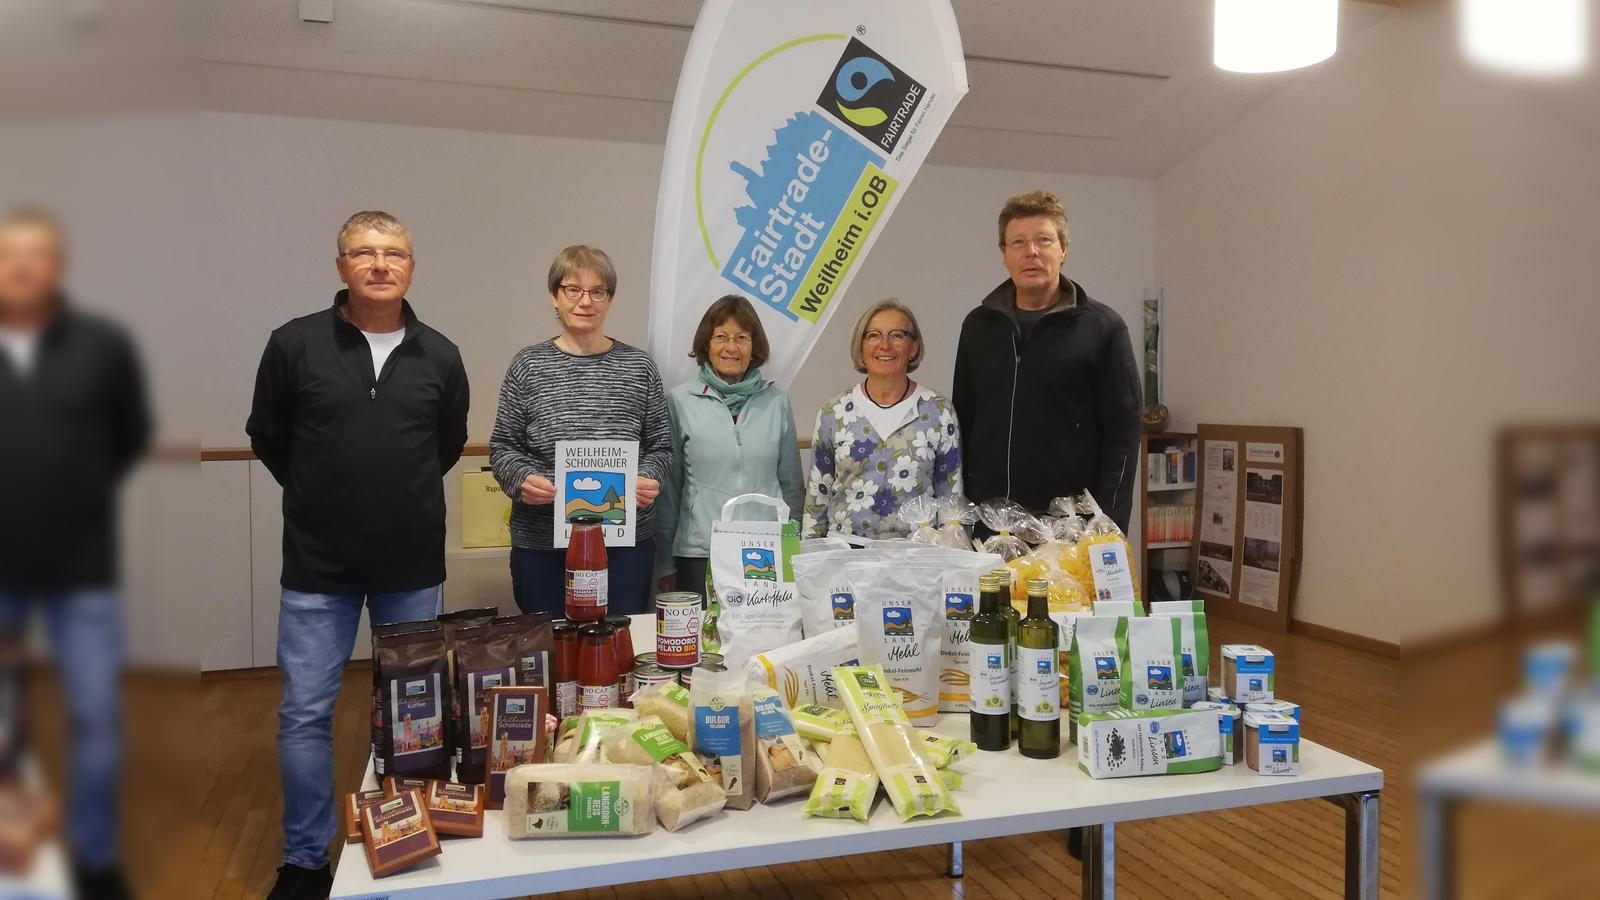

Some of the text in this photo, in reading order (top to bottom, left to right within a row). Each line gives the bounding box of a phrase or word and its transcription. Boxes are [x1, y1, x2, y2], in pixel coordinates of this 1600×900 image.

[880, 84, 921, 148] FAIRTRADE
[895, 151, 904, 161] Das
[902, 135, 913, 150] Siegel
[732, 129, 833, 288] Fairtrade-
[799, 174, 888, 314] Weilheim i.OB
[759, 211, 826, 303] Stadt
[565, 447, 628, 457] WEILHEIM-
[565, 458, 627, 468] SCHONGAUER
[564, 528, 625, 539] LND
[744, 581, 778, 589] LAND
[747, 590, 793, 607] Kartoffeln
[666, 607, 698, 616] NO CAP
[658, 637, 696, 646] POMODORO
[684, 644, 696, 652] BIO
[888, 643, 920, 662] Mehl
[820, 670, 838, 702] Mehl
[1101, 688, 1120, 698] Linse
[1150, 697, 1177, 708] Linsen
[498, 721, 532, 729] Schokolade
[705, 715, 730, 724] BULGUR
[1148, 736, 1160, 766] Linsen
[592, 800, 600, 816] REIS
[601, 786, 610, 828] LANGKORN-
